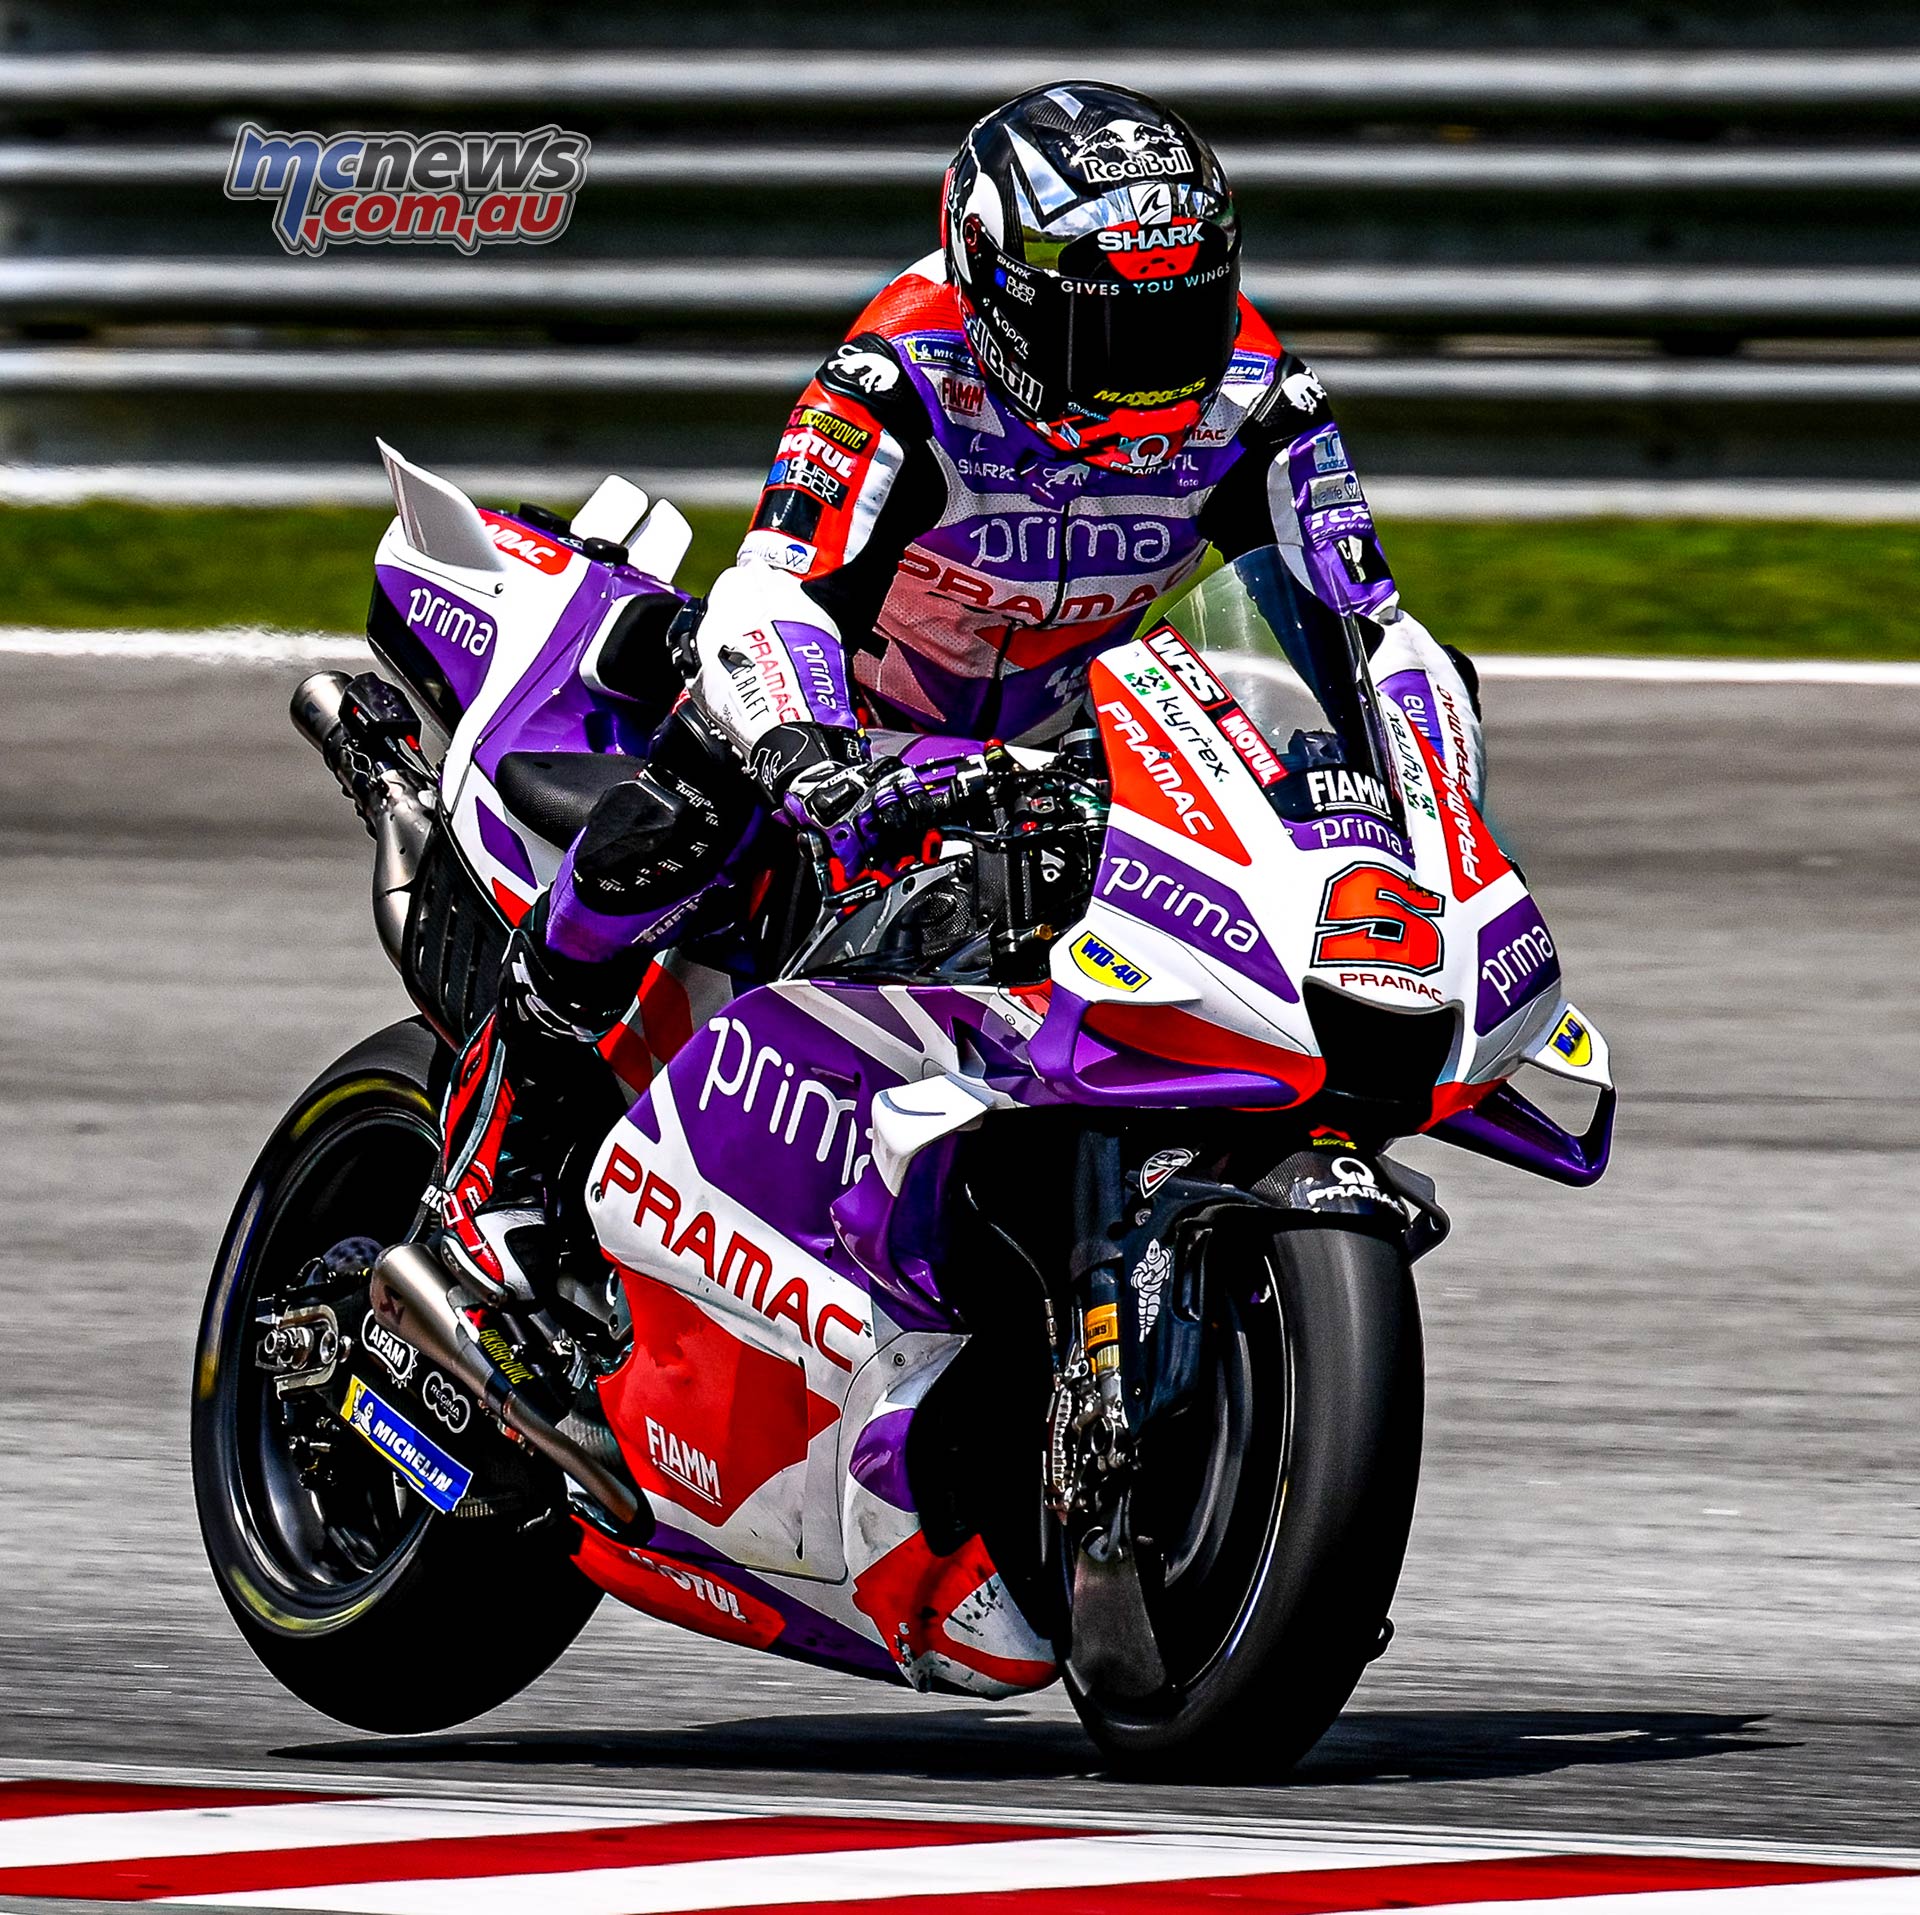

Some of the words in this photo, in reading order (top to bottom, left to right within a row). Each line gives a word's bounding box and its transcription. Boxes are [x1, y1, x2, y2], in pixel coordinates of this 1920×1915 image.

[1097, 222, 1205, 253] SHARK
[996, 254, 1032, 280] SHARK
[1061, 280, 1121, 296] GIVES
[1133, 279, 1174, 294] YOU
[1185, 262, 1231, 288] WINGS
[1005, 284, 1034, 306] LOCK
[785, 470, 836, 504] LOCK
[789, 456, 840, 492] QUAD
[969, 516, 1171, 568] prima
[406, 587, 494, 657] prima
[743, 628, 801, 724] PRAMAC
[793, 641, 837, 710] prima
[1097, 700, 1216, 835] PRAMAC
[1220, 713, 1281, 788] MOTUL
[1306, 770, 1392, 816] FIAMM
[1311, 817, 1403, 856] prima
[1432, 754, 1484, 886] PRAMAC
[1102, 856, 1260, 953] prima
[1080, 937, 1142, 986] WD-40
[1481, 925, 1555, 1007] prima
[1339, 973, 1445, 1006] PRAMAC
[600, 1142, 865, 1374] PRAMAC
[368, 1324, 407, 1370] AFAM
[430, 1384, 460, 1418] REGINA
[372, 1418, 453, 1493] MICHELIN
[645, 1415, 722, 1500] FIAMM
